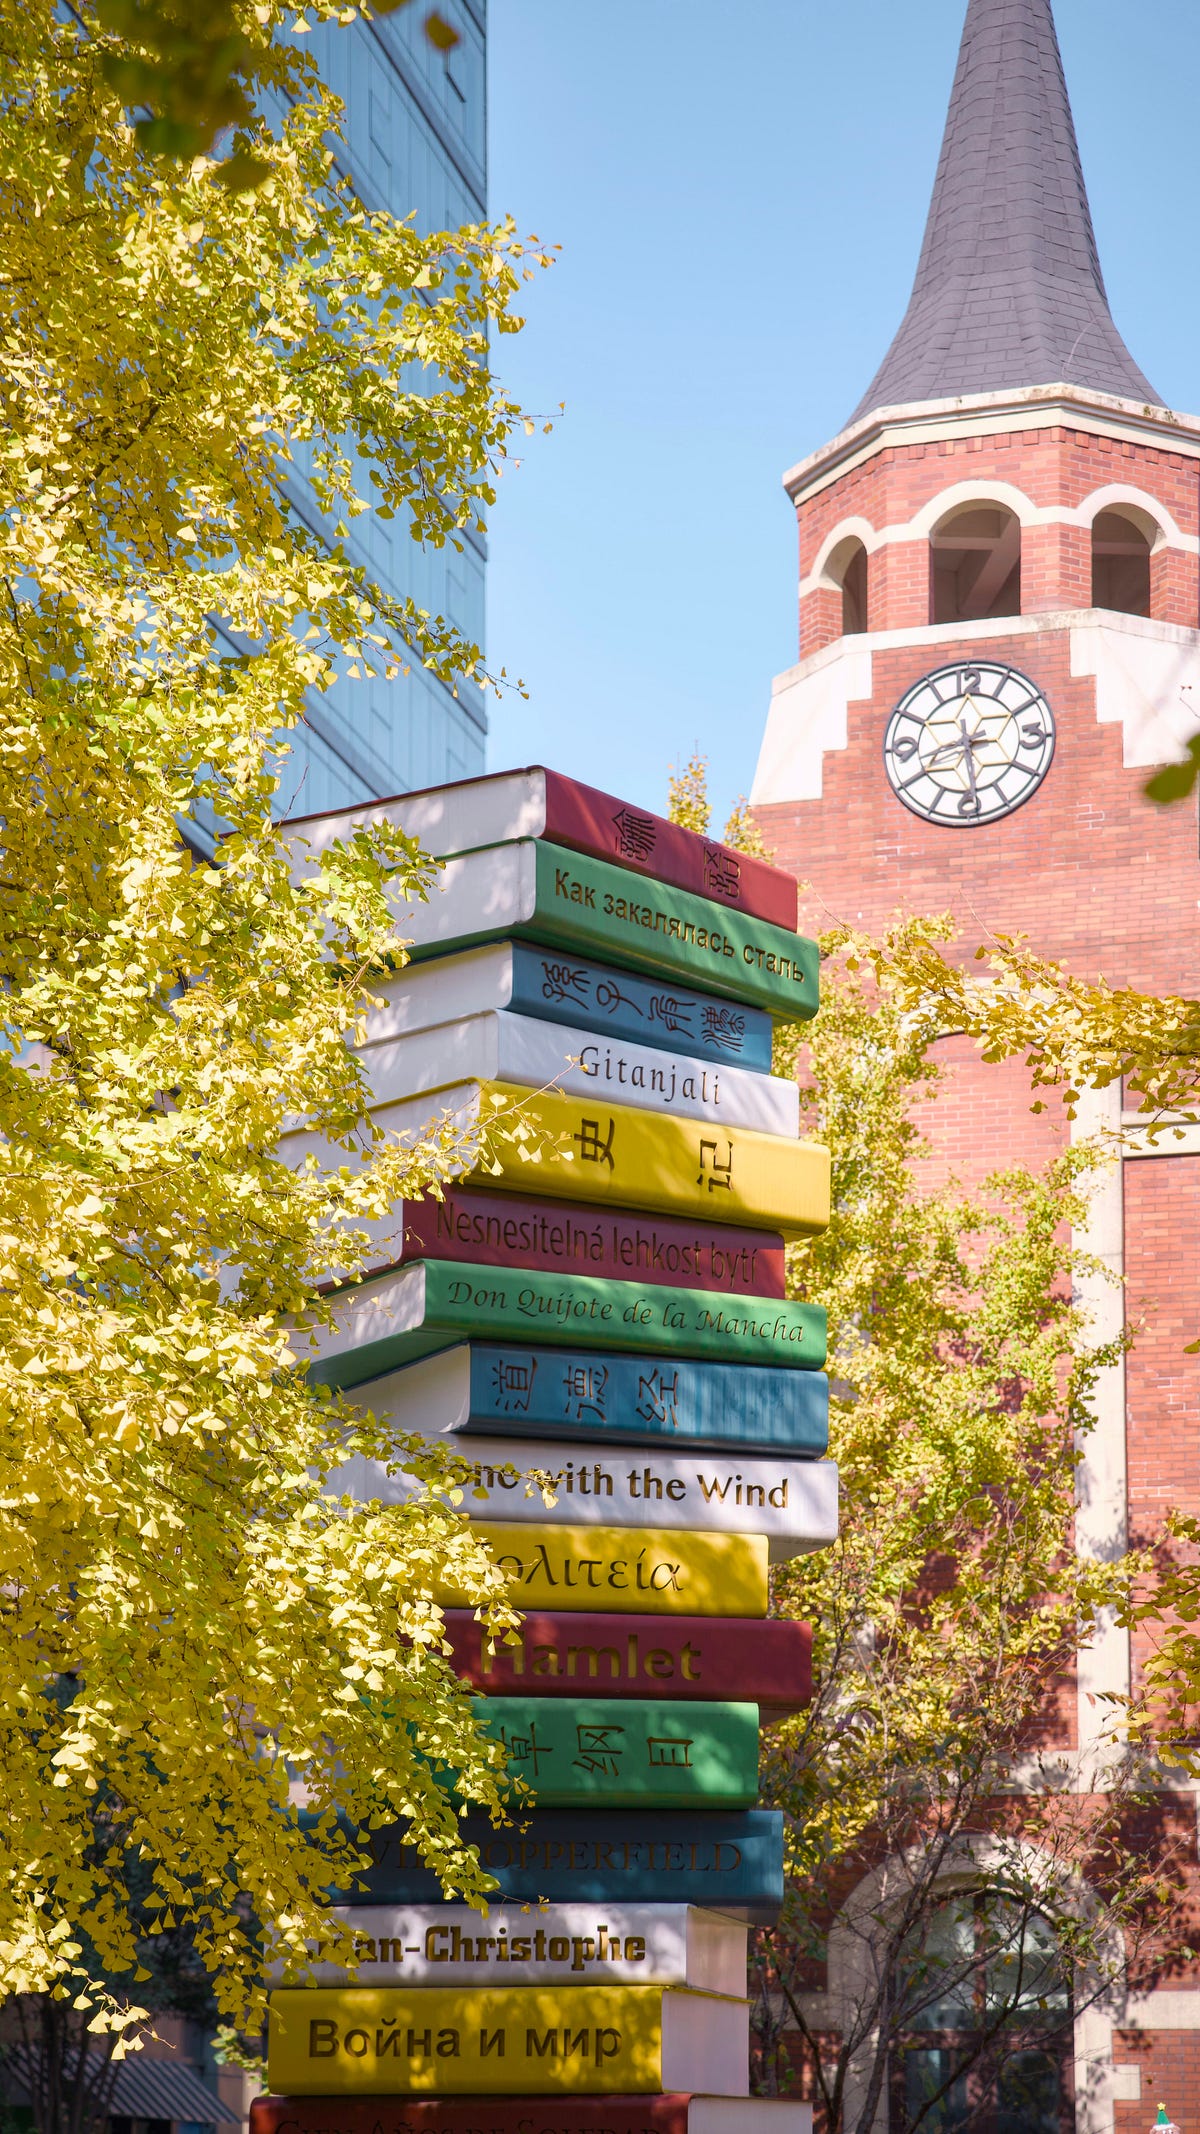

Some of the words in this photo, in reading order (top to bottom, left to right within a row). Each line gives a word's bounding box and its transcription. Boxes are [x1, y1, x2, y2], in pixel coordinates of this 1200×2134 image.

[956, 668, 981, 695] 12
[893, 736, 918, 763] 9
[1020, 722, 1046, 750] 3
[958, 789, 982, 816] 6
[555, 867, 596, 909] Как
[603, 892, 735, 959] закалялась
[742, 943, 805, 984] сталь
[579, 1045, 721, 1105] Gitanjali
[573, 1116, 735, 1193] 史记
[436, 1202, 604, 1262] Nesnesitelná
[613, 1225, 702, 1276] lehkost
[711, 1242, 758, 1288] bytí
[447, 1280, 507, 1309] Don
[516, 1287, 613, 1325] Quijote
[623, 1299, 653, 1326] de
[662, 1302, 686, 1329] la
[695, 1309, 806, 1343] Mancha
[491, 1356, 679, 1428] 道德经
[626, 1468, 687, 1501] the
[696, 1474, 790, 1509] Wind
[476, 1543, 685, 1592] ολιτεία
[480, 1629, 702, 1681] Hamlet
[484, 1839, 742, 1872] OPPERFIELD
[308, 2017, 461, 2059] Война
[479, 2027, 505, 2057] и
[526, 2027, 623, 2068] мир
